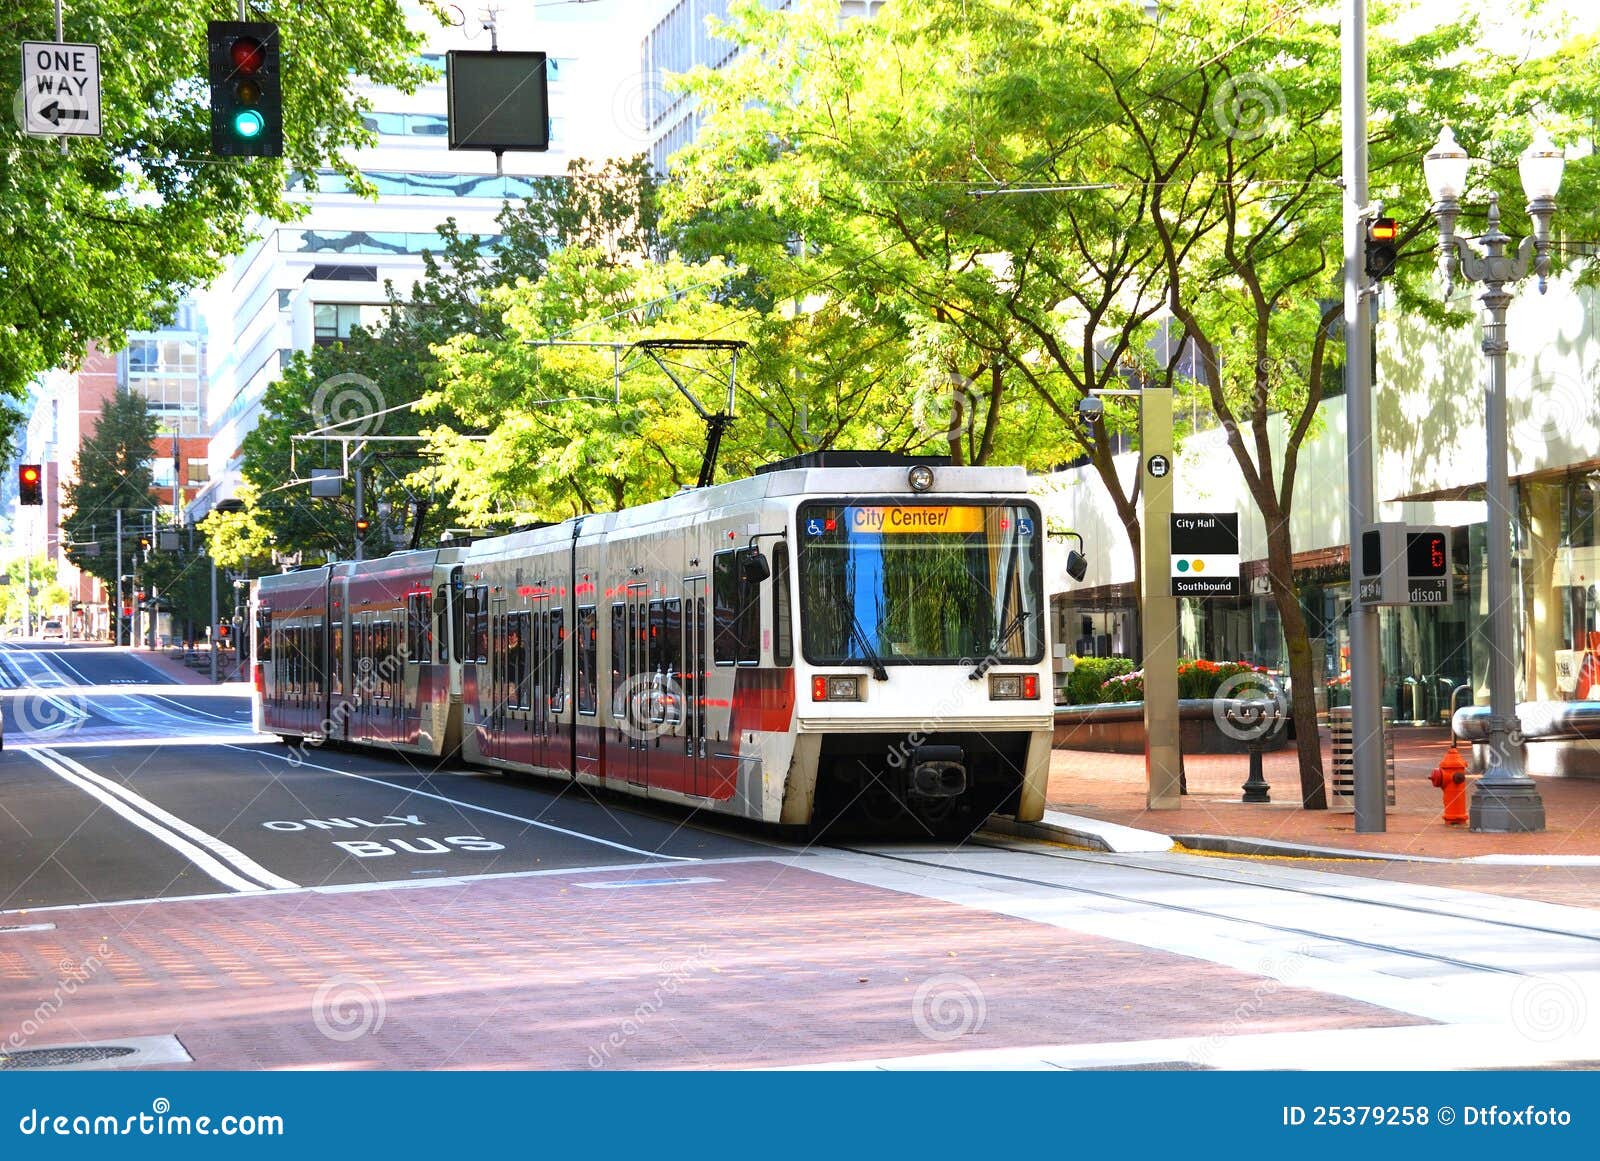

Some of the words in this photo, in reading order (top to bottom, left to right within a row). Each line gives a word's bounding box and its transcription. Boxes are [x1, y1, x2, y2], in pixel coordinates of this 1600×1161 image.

[37, 50, 86, 72] ONE
[36, 75, 88, 96] WAY
[854, 508, 885, 530] City
[891, 508, 949, 526] Center/
[1176, 519, 1195, 530] City
[1197, 518, 1215, 528] Hall
[1431, 539, 1443, 567] 6
[1177, 582, 1232, 591] Southbound
[262, 815, 426, 831] ONLY
[332, 836, 505, 858] BUS
